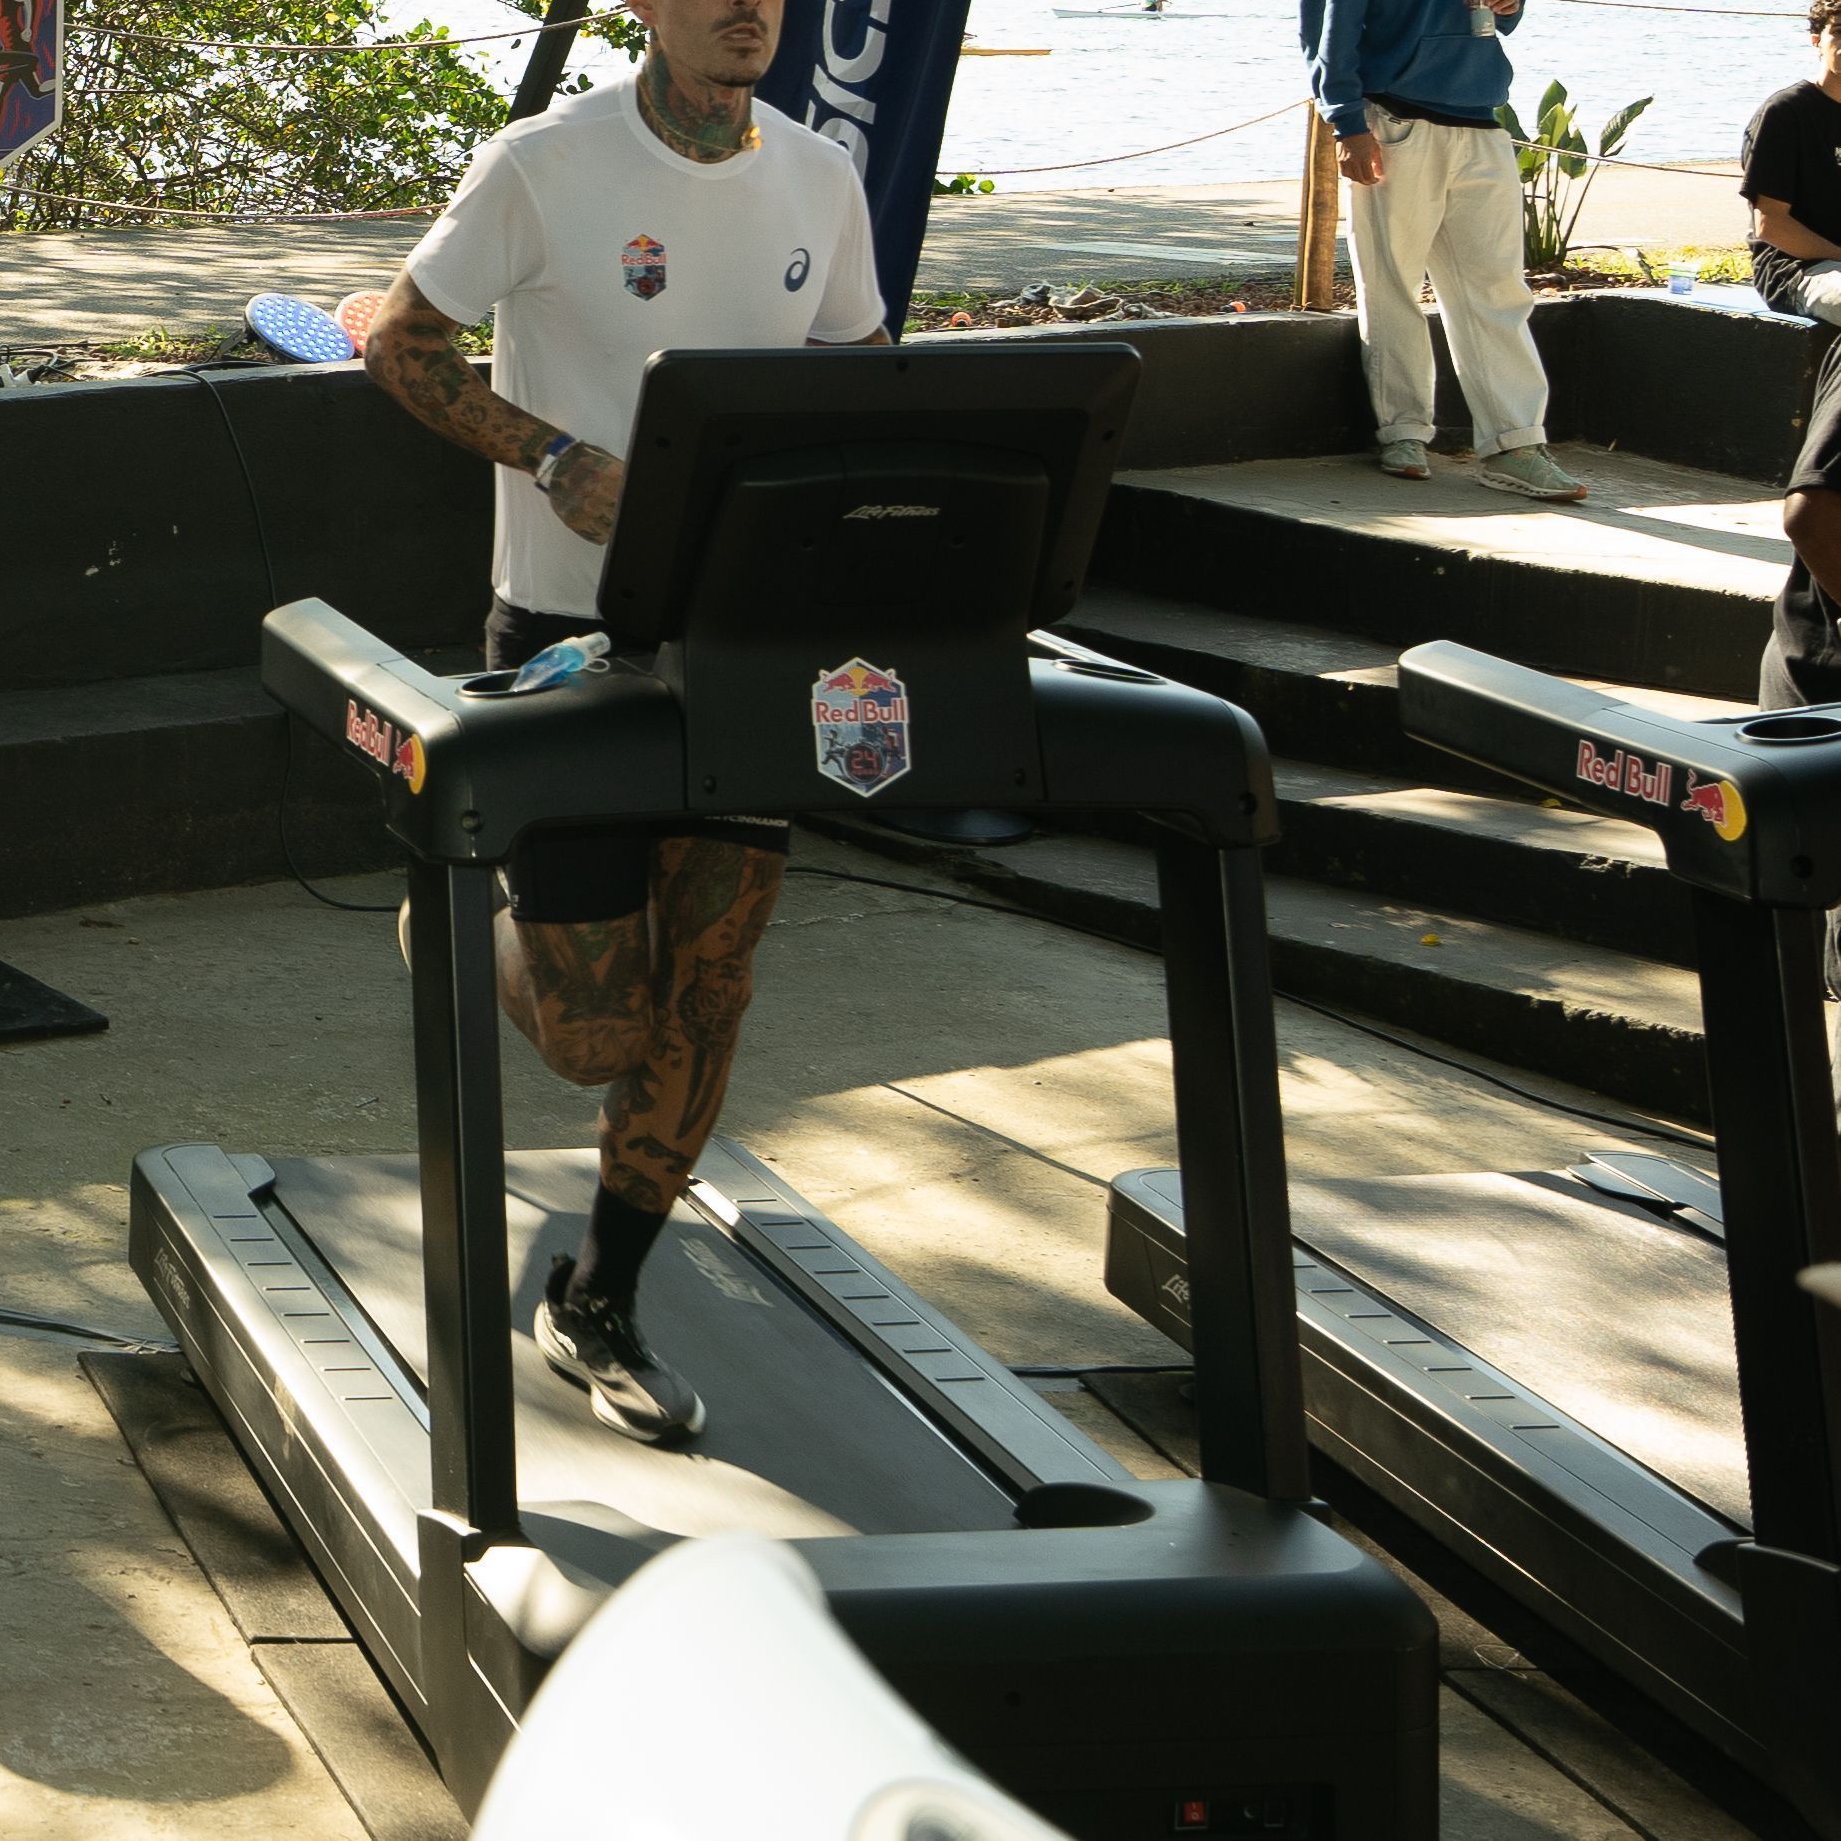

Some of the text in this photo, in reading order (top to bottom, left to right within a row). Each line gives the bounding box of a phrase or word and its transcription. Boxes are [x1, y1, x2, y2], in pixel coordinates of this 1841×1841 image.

[816, 699, 905, 723] Red Bull
[1577, 739, 1672, 807] Red Bull
